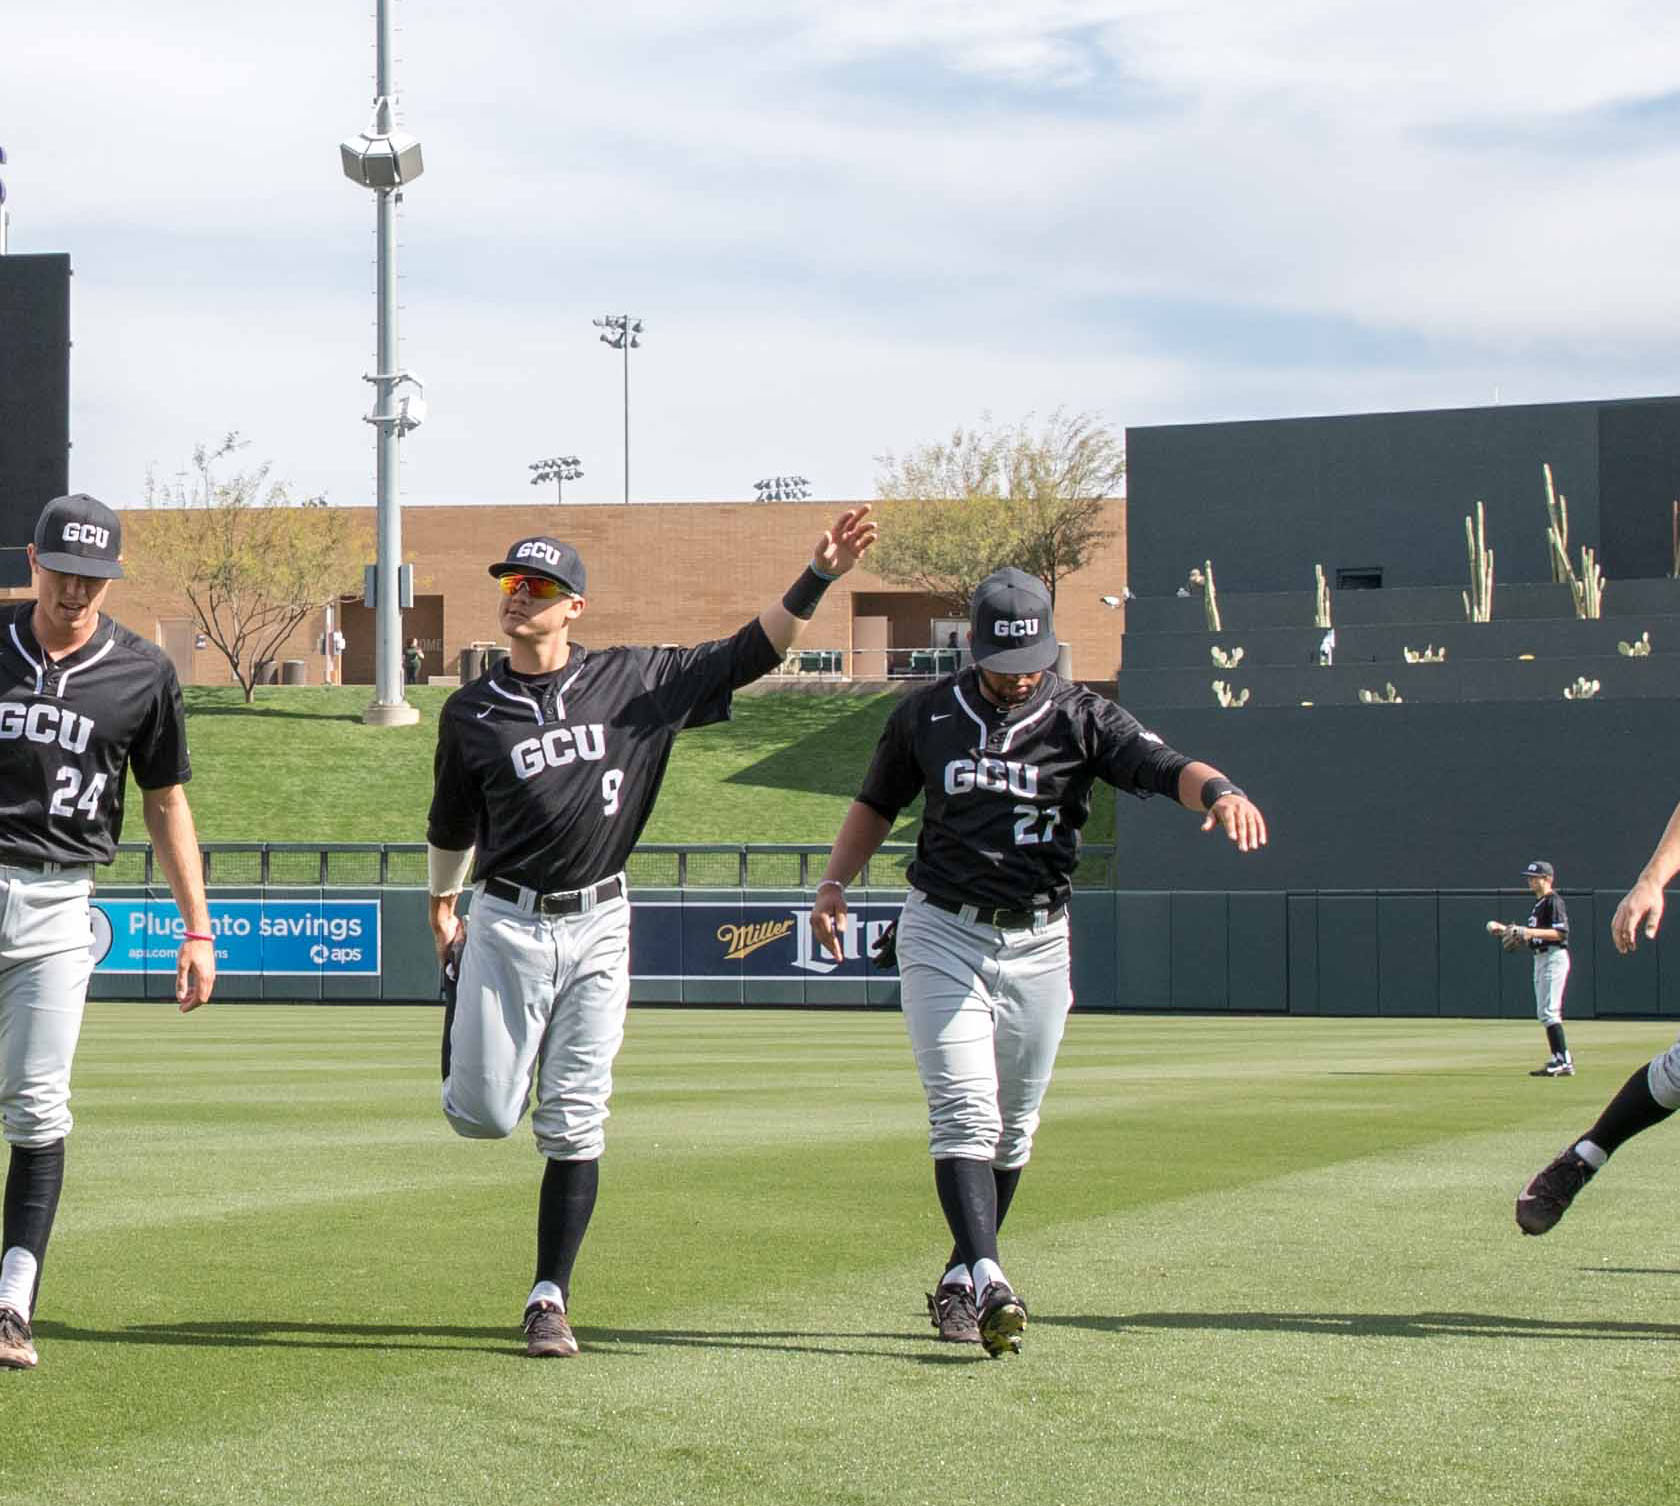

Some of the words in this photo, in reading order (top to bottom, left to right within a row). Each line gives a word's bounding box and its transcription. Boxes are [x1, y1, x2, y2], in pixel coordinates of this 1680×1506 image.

[62, 522, 110, 549] GCU
[516, 542, 561, 565] GCU
[994, 618, 1039, 637] GCU
[510, 723, 606, 780] GCU
[49, 765, 108, 820] 24
[601, 768, 624, 816] 9
[944, 759, 1040, 799] GCU
[1013, 804, 1062, 846] 27
[129, 912, 187, 939] Plug
[211, 914, 251, 936] nto
[259, 912, 362, 941] savings
[717, 920, 795, 953] Miller
[791, 911, 892, 973] Lte
[330, 948, 362, 964] aps
